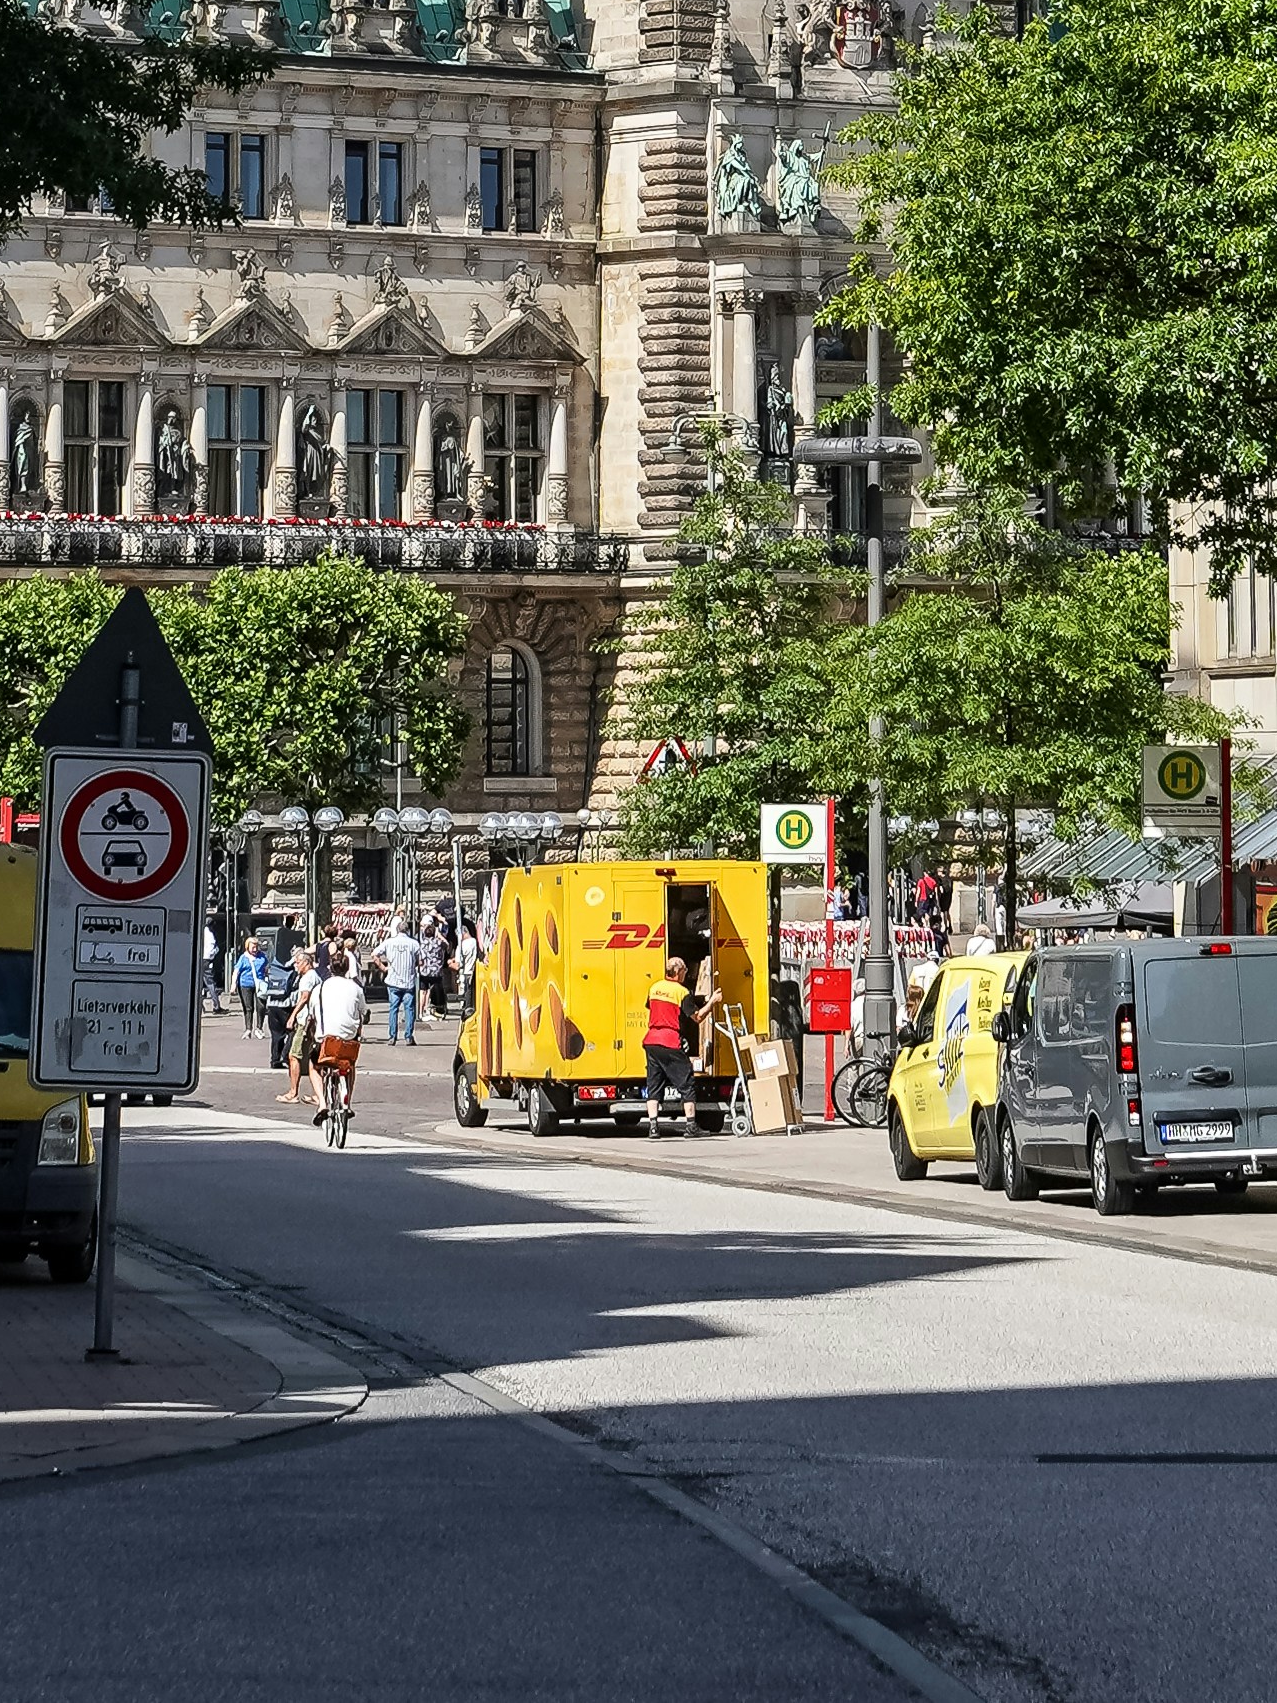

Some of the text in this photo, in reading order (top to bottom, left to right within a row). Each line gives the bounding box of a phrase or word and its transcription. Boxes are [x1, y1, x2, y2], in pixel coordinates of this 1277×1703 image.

[1171, 762, 1193, 788] H
[786, 819, 802, 840] H
[125, 919, 161, 937] Taxen
[127, 947, 150, 963] frei
[77, 997, 158, 1016] Lieferverkehr
[86, 1019, 102, 1036] 21
[122, 1019, 133, 1036] 11
[138, 1020, 145, 1036] h
[103, 1040, 128, 1056] frei
[1205, 1122, 1231, 1136] 2999
